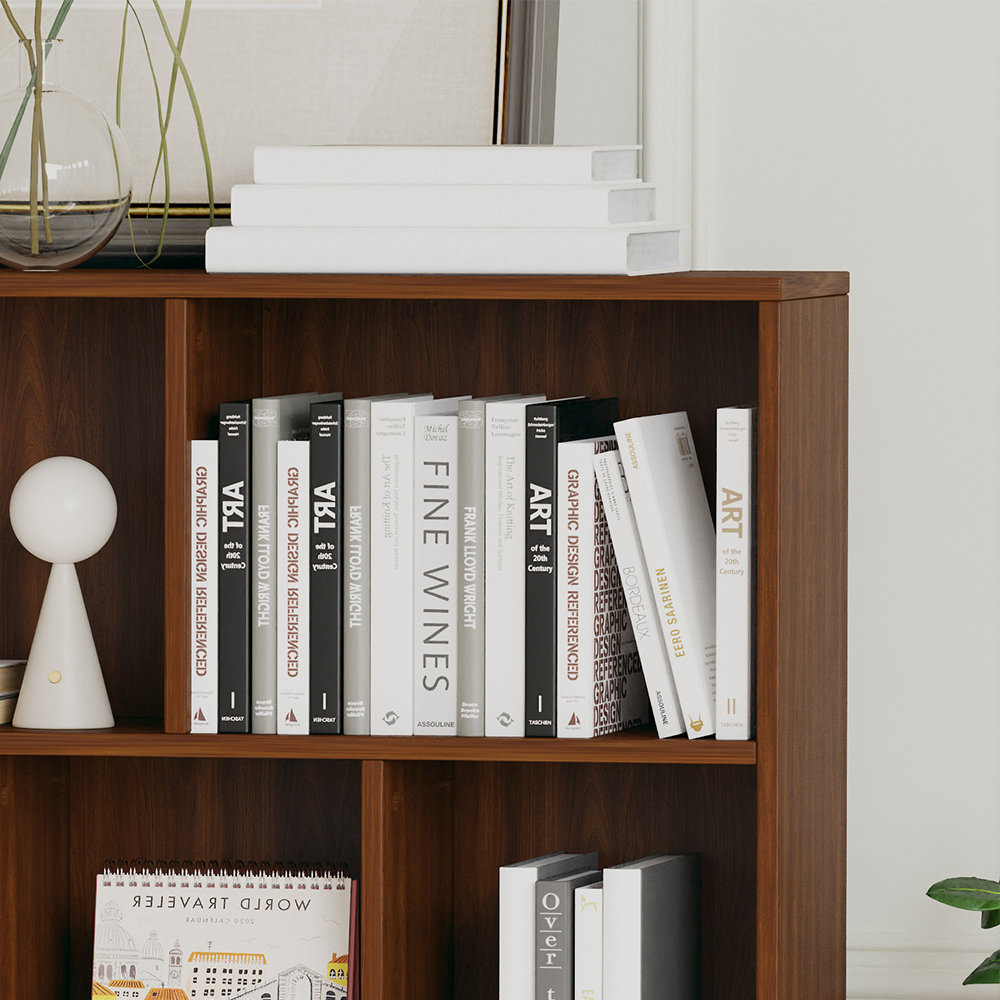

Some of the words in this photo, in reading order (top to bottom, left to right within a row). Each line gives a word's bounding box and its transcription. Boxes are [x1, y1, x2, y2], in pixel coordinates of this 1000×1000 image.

[424, 424, 449, 433] Michel
[506, 456, 516, 472] The
[625, 431, 639, 469] ASSOULINE
[506, 475, 516, 489] Art
[567, 469, 579, 531] GRAPHIC
[423, 461, 449, 544] FINE
[530, 483, 552, 536] ART
[721, 487, 743, 539] ART
[463, 506, 476, 545] FRANK
[504, 503, 516, 540] Knitting
[463, 546, 476, 582] LLOYD
[531, 544, 539, 552] of
[539, 544, 550, 552] the
[567, 536, 579, 586] DESIGN
[722, 547, 730, 556] of
[731, 547, 742, 556] the
[724, 557, 739, 566] 20th
[527, 564, 553, 574] Century
[719, 568, 745, 577] Century
[463, 584, 476, 629] WRIGHT
[622, 566, 652, 641] BORDEAUX
[655, 567, 678, 625] SAARINEN
[423, 564, 449, 692] WINES
[567, 591, 579, 681] REFERENCED
[594, 609, 627, 637] GRAPHIC
[594, 633, 621, 660] DESIGN
[670, 629, 686, 658] EERO
[593, 676, 627, 705] GRAPHIC
[593, 700, 622, 728] DESIGN
[542, 892, 560, 965] Over
